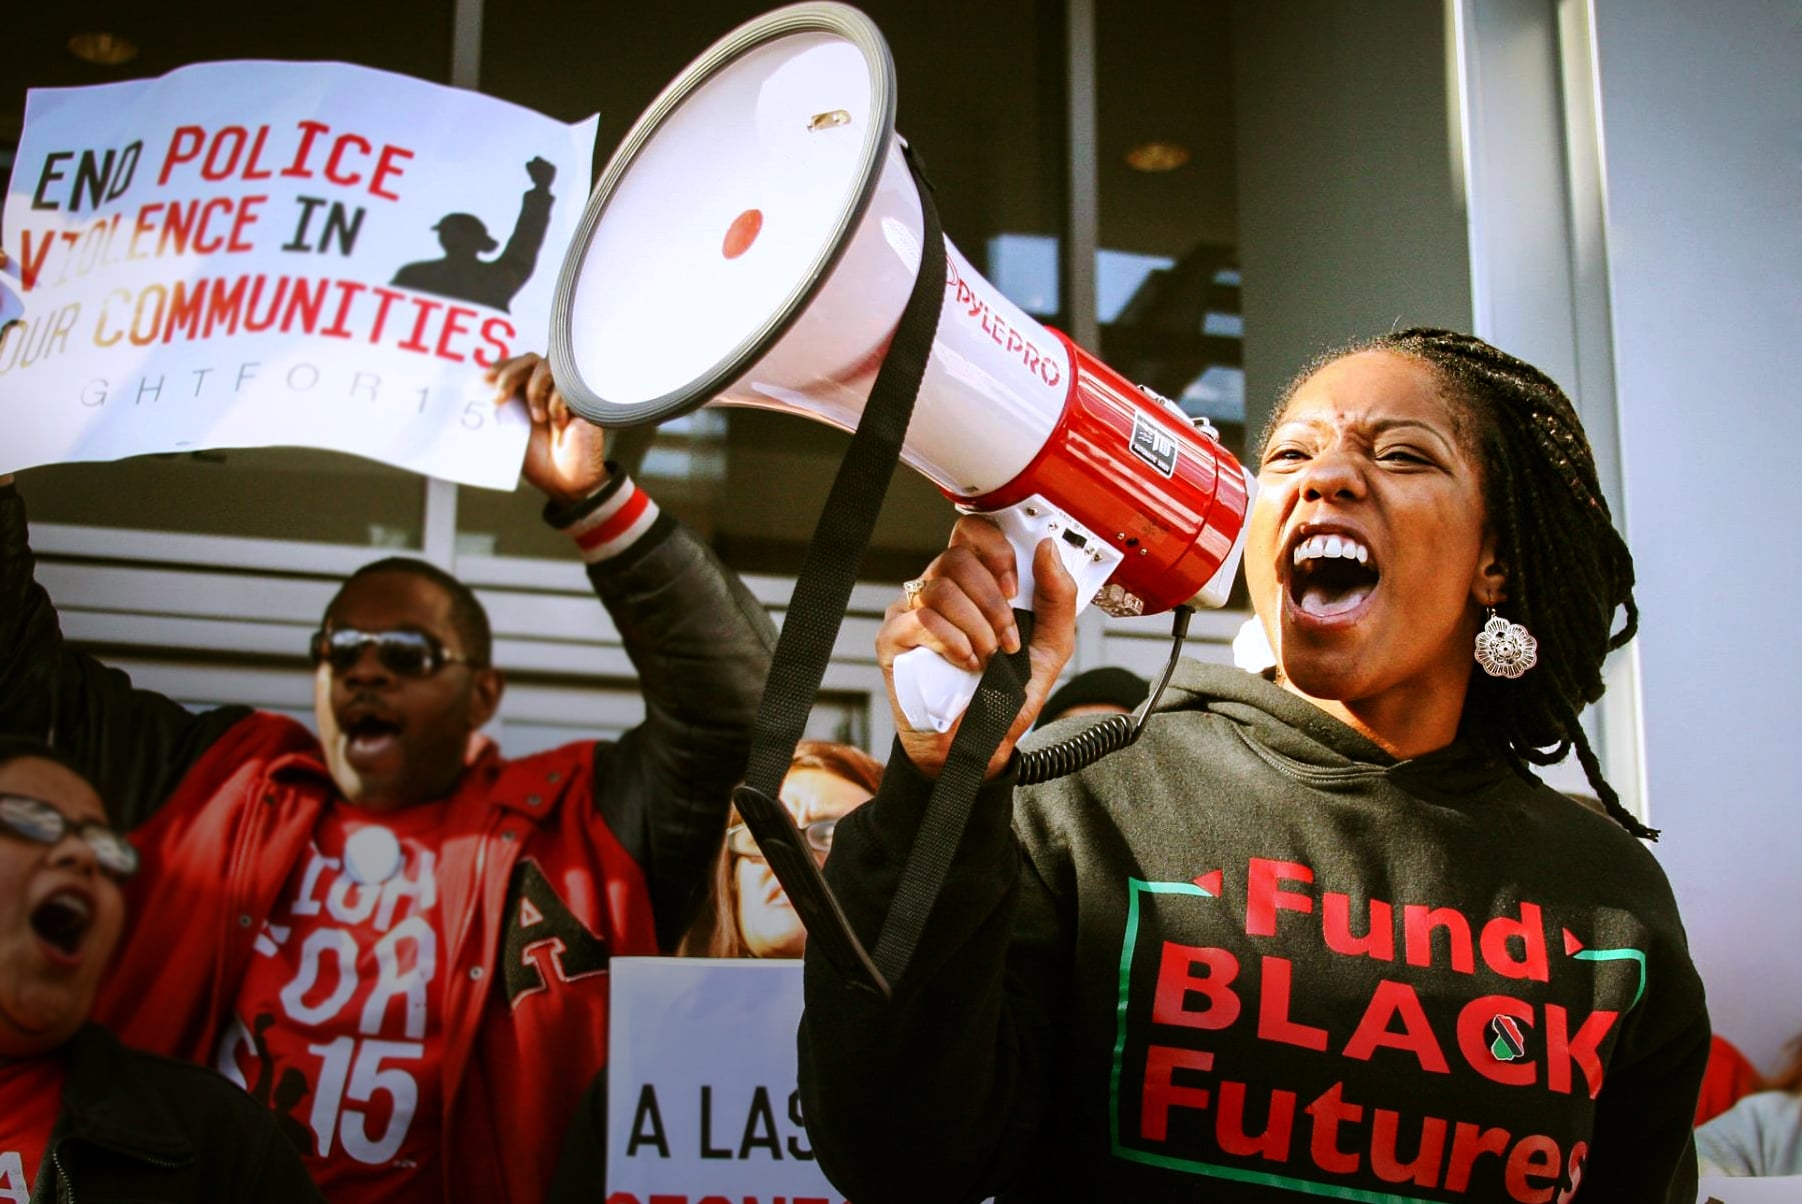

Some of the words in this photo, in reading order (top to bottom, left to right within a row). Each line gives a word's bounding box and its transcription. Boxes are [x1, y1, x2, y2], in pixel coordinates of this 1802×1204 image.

[31, 140, 144, 212] END
[157, 120, 415, 202] POLICE
[21, 195, 269, 292] VIOLENCE
[282, 196, 367, 257] IN
[0, 301, 81, 376] OUR
[93, 275, 517, 369] COMMUNITIES
[1246, 857, 1549, 983] Fund
[1152, 940, 1619, 1100] BLACK
[626, 1083, 671, 1159] A
[1141, 1045, 1588, 1204] Futures
